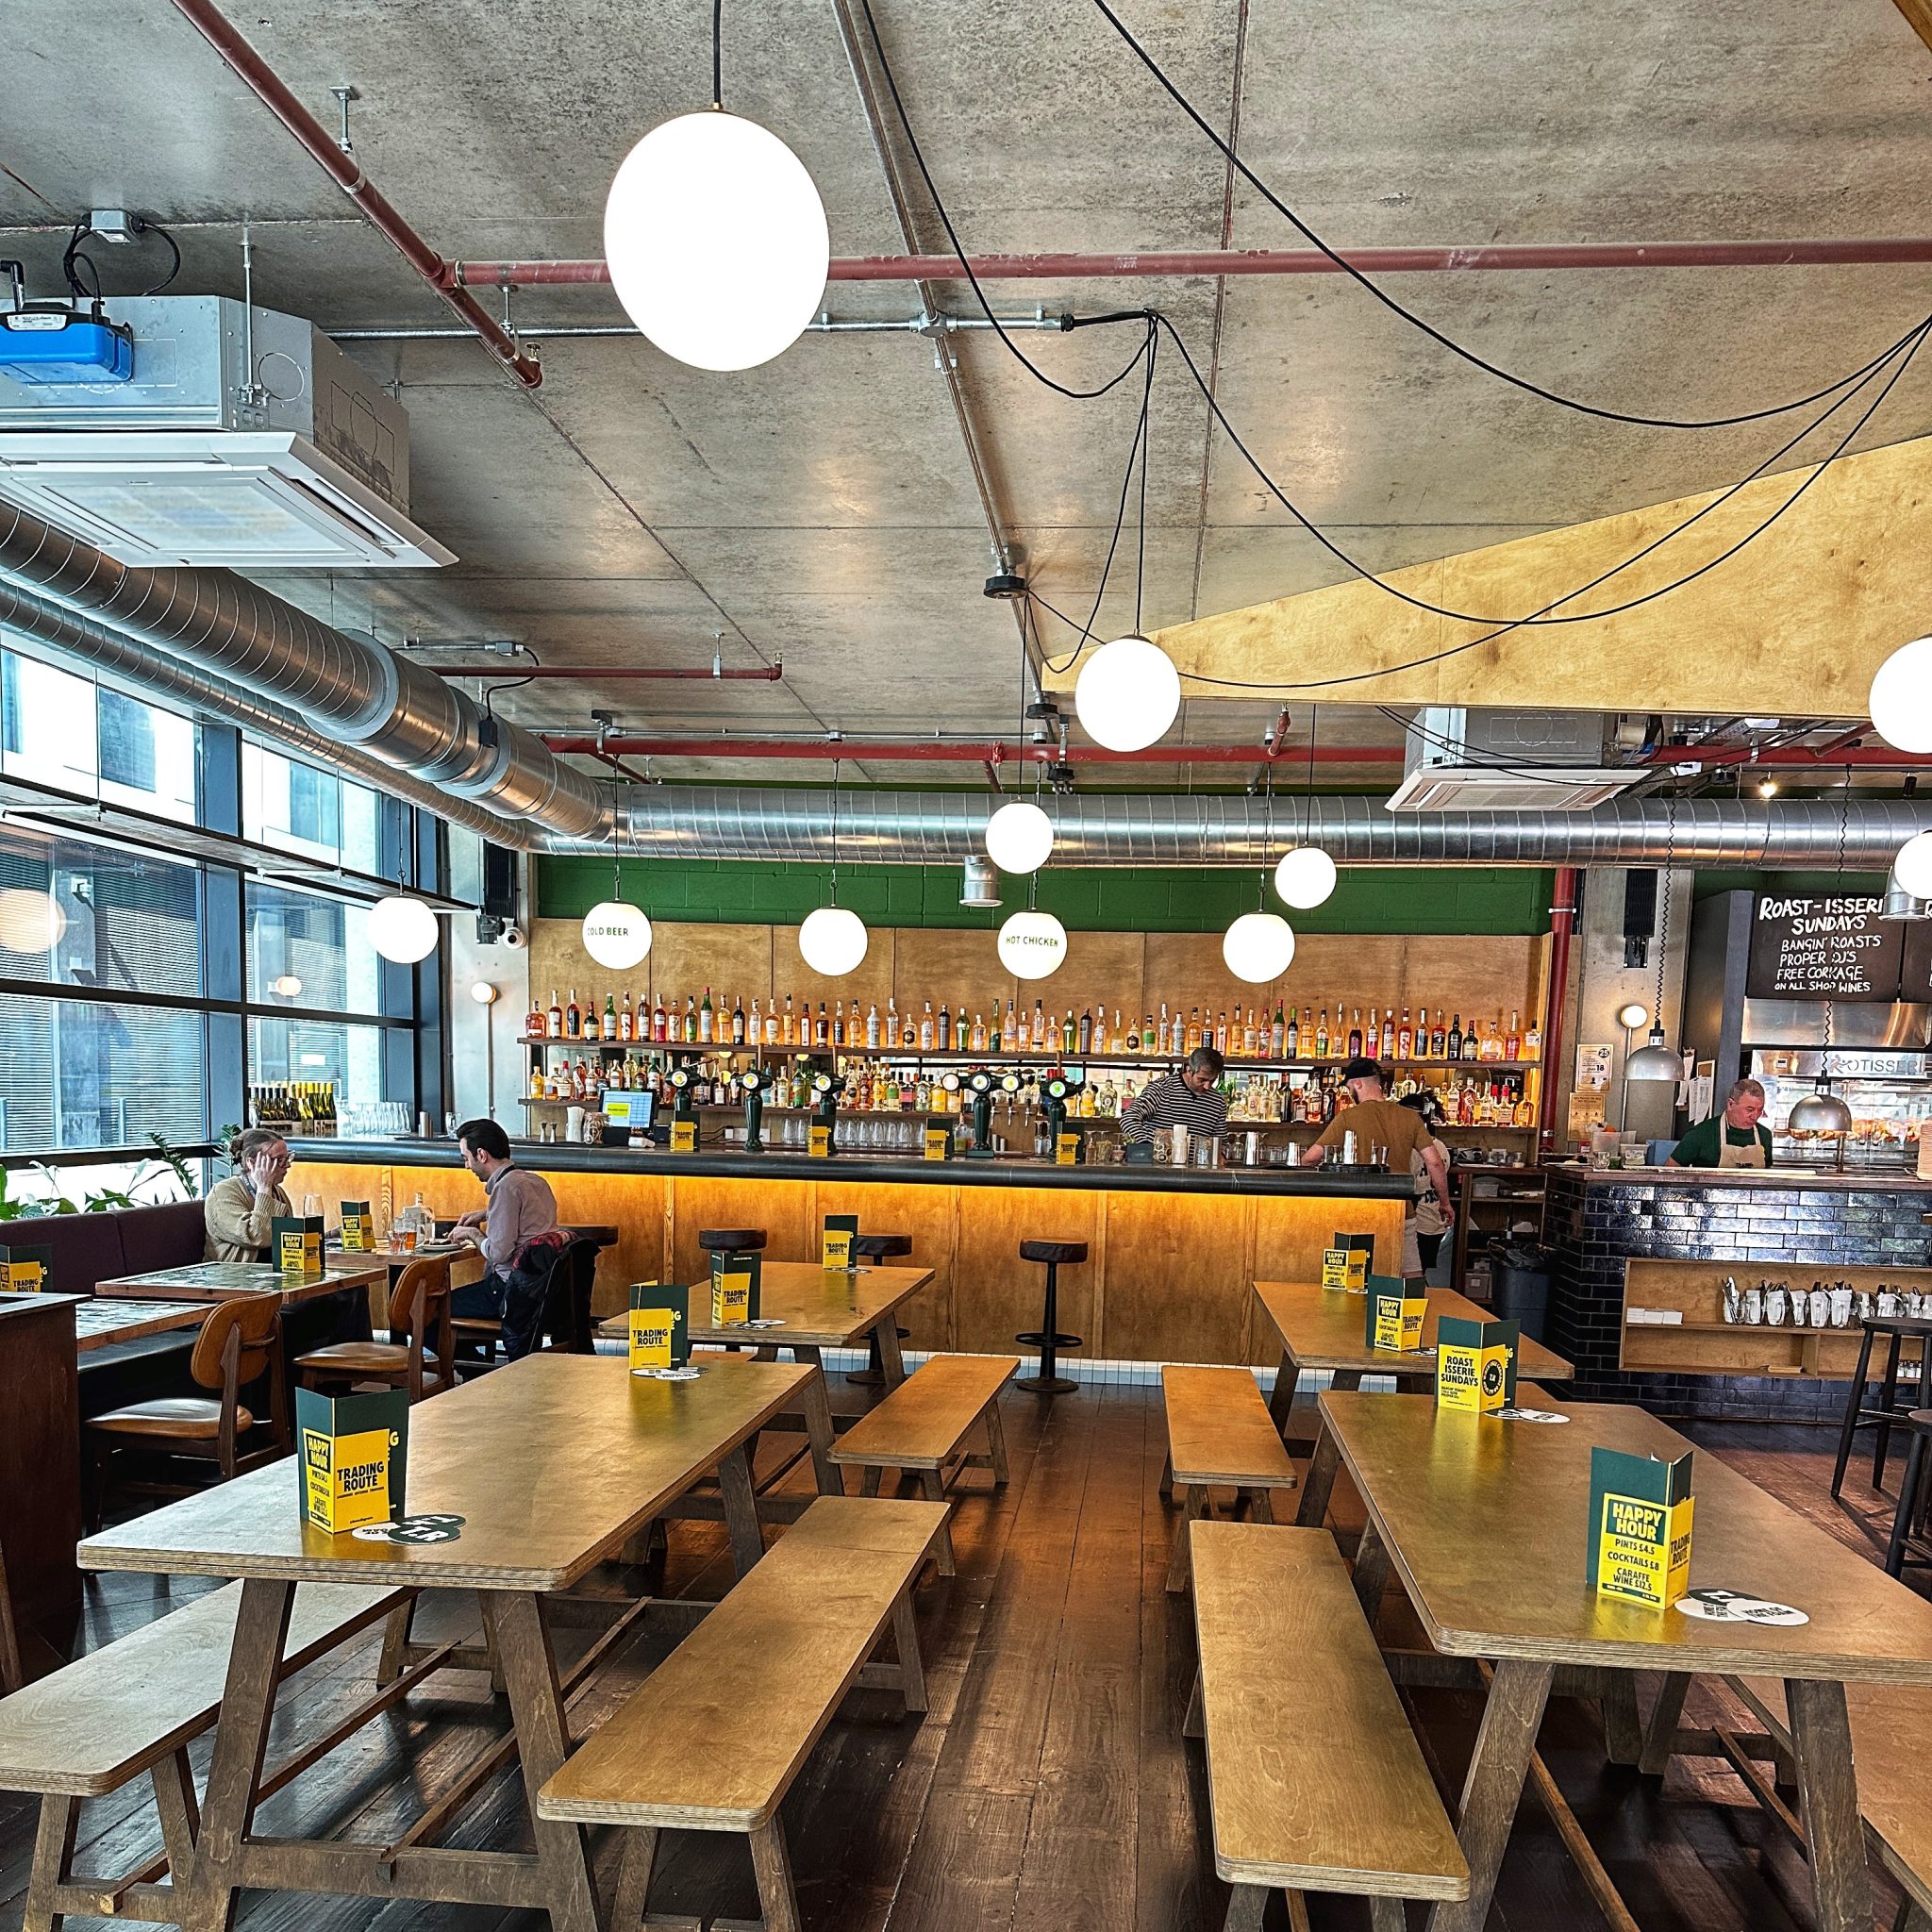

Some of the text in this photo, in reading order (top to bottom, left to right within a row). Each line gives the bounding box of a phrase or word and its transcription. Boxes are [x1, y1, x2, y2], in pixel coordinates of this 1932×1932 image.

[1759, 897, 1884, 920] ROAST-ISSERI
[588, 927, 628, 936] COLD BEER
[1791, 915, 1867, 935] SUNDAYS
[1007, 936, 1058, 947] HOT CHICKEN
[1781, 935, 1882, 952] BANGIN' ROASTS
[1780, 951, 1826, 967] PROPER
[1777, 966, 1863, 981] FREE CORKAGE
[1774, 980, 1871, 992] ON ALL SHOP WINES
[1599, 1049, 1608, 1058] 25
[13, 1278, 38, 1287] TRADING
[1380, 1300, 1399, 1309] HAPPY
[1382, 1307, 1397, 1317] HOUR
[632, 1329, 668, 1338] TRADING
[638, 1337, 663, 1345] ROUTE
[1446, 1356, 1474, 1367] ROAST
[1444, 1364, 1475, 1377] ISSERIE
[1441, 1374, 1478, 1387] SUNDAYS
[308, 1436, 329, 1456] HAPPY
[310, 1451, 328, 1471] HOUR
[337, 1461, 384, 1481] TRADING
[343, 1474, 377, 1492] ROUTE
[1612, 1502, 1662, 1527] HAPPY
[1616, 1518, 1657, 1541] HOUR
[1615, 1539, 1655, 1555] PINTS £4.5
[1671, 1532, 1690, 1554] TRADING
[1607, 1552, 1649, 1568] COCKTAILS
[1650, 1562, 1659, 1571] £8
[1673, 1547, 1688, 1565] ROUTE
[1613, 1574, 1634, 1586] WINE
[1634, 1580, 1652, 1591] £12.5
[1617, 1568, 1650, 1582] CARAFFE
